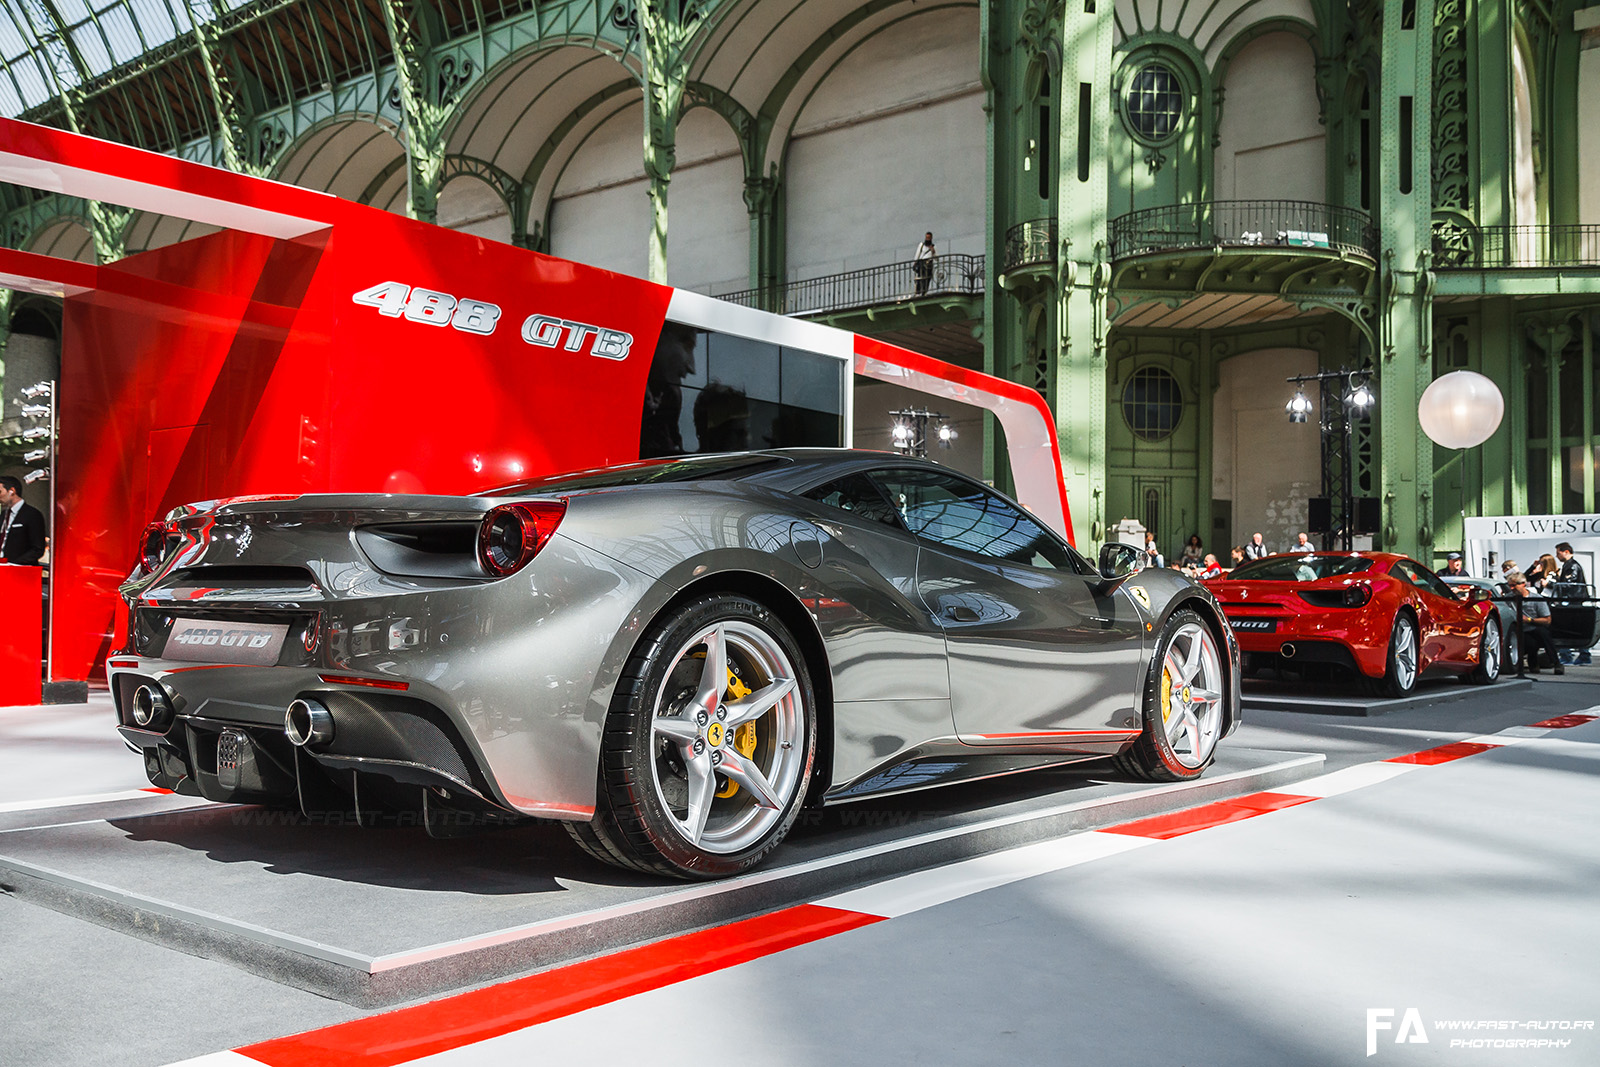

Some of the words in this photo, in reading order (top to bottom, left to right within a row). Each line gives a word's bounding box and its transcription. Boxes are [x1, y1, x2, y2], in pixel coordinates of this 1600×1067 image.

[352, 281, 502, 336] 488
[521, 313, 633, 361] GTB
[1493, 520, 1526, 535] J.M.
[220, 629, 272, 648] GTB
